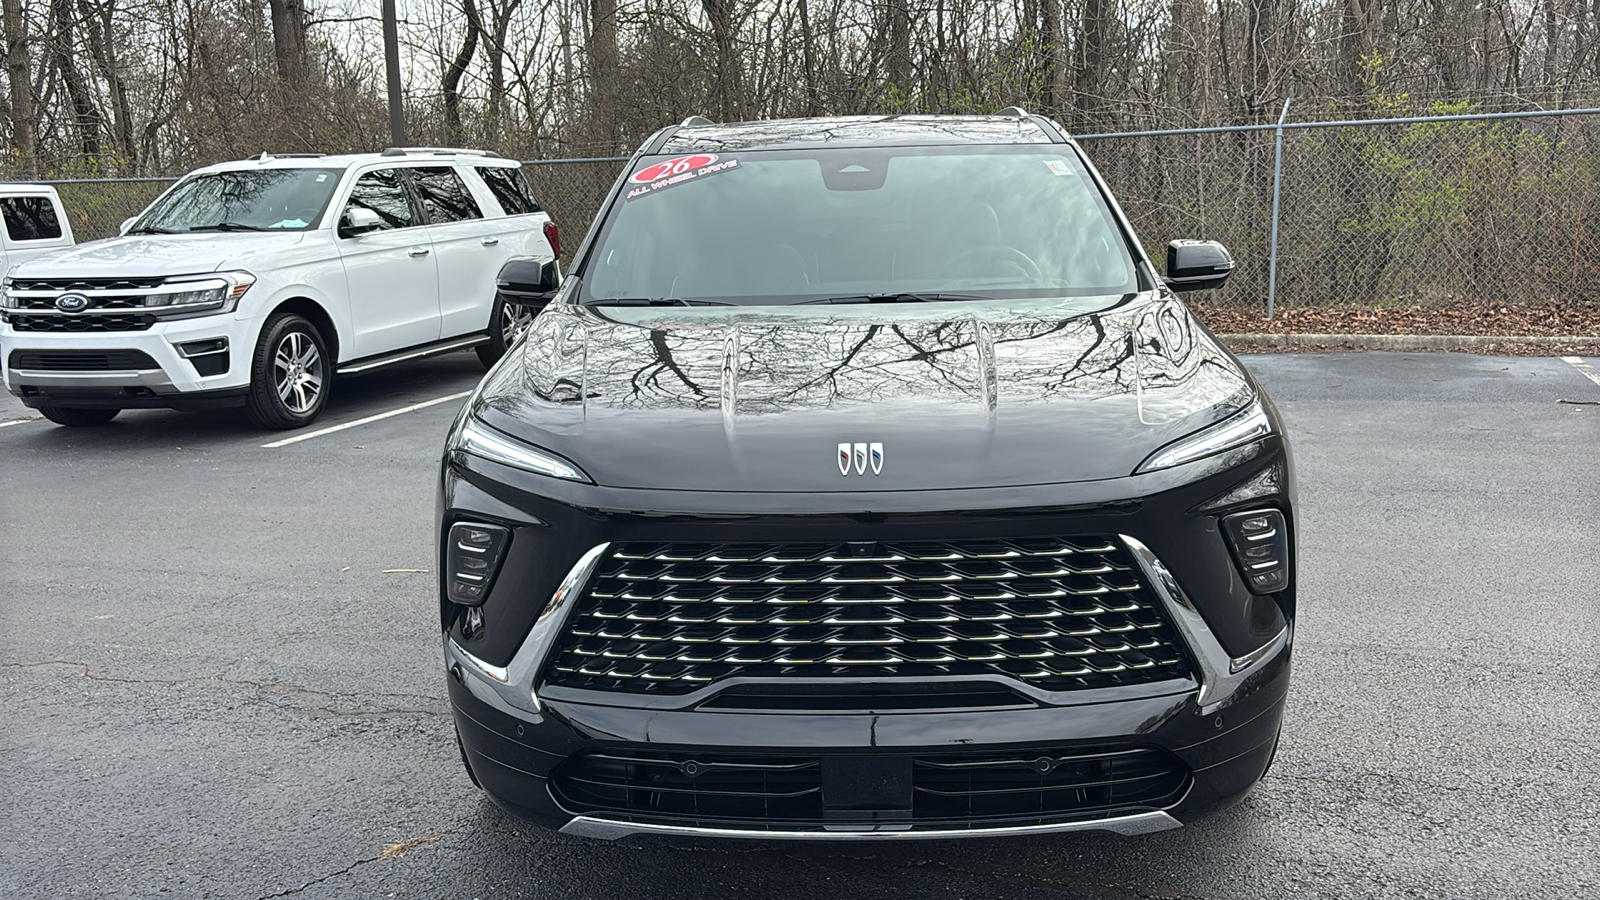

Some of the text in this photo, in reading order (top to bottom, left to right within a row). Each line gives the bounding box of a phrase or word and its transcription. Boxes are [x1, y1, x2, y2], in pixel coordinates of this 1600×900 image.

[627, 159, 738, 199] ALL WHEEL DRIVE
[653, 157, 692, 181] 26
[61, 297, 80, 307] Ford
